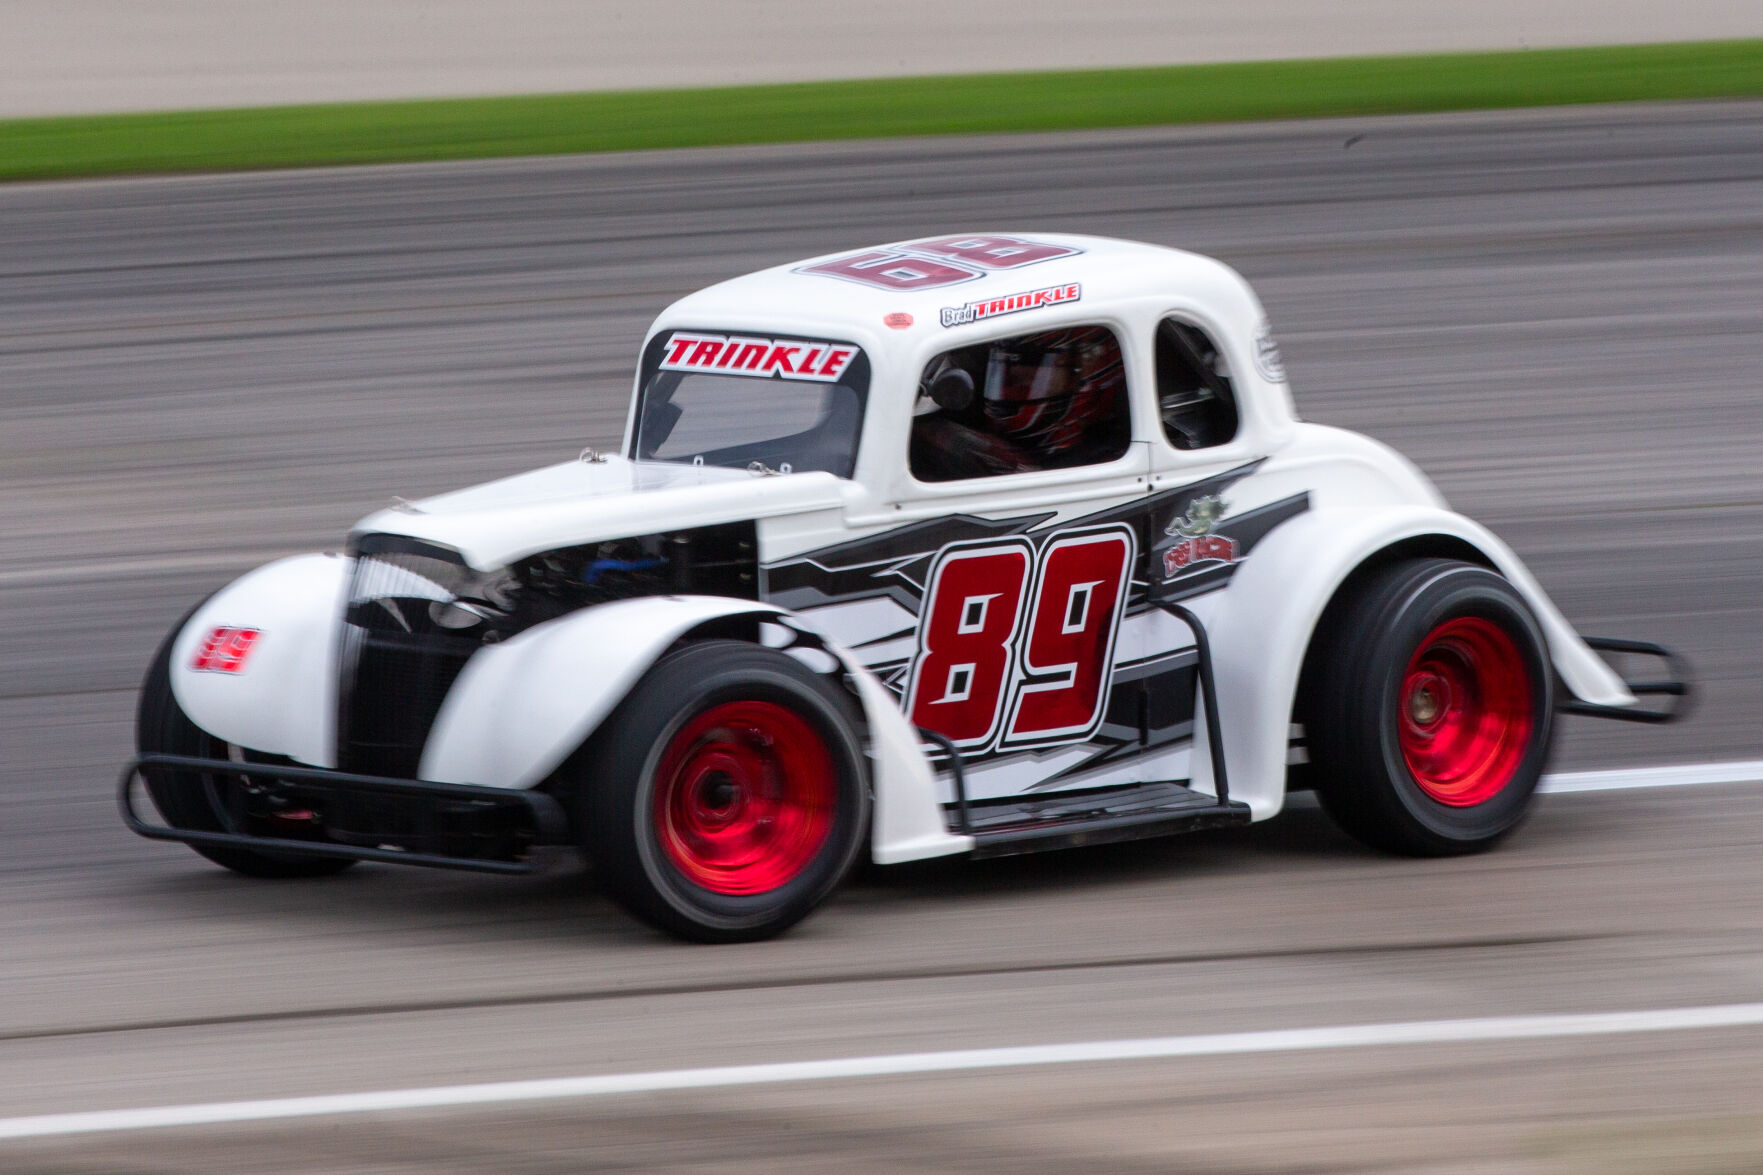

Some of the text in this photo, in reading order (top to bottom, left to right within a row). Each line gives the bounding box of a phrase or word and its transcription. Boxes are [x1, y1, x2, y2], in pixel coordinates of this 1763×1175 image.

[943, 306, 973, 325] Brad
[974, 285, 1080, 318] TRINKLE
[664, 337, 853, 378] TRINKLE
[186, 626, 264, 673] 89
[904, 529, 1131, 747] 89
